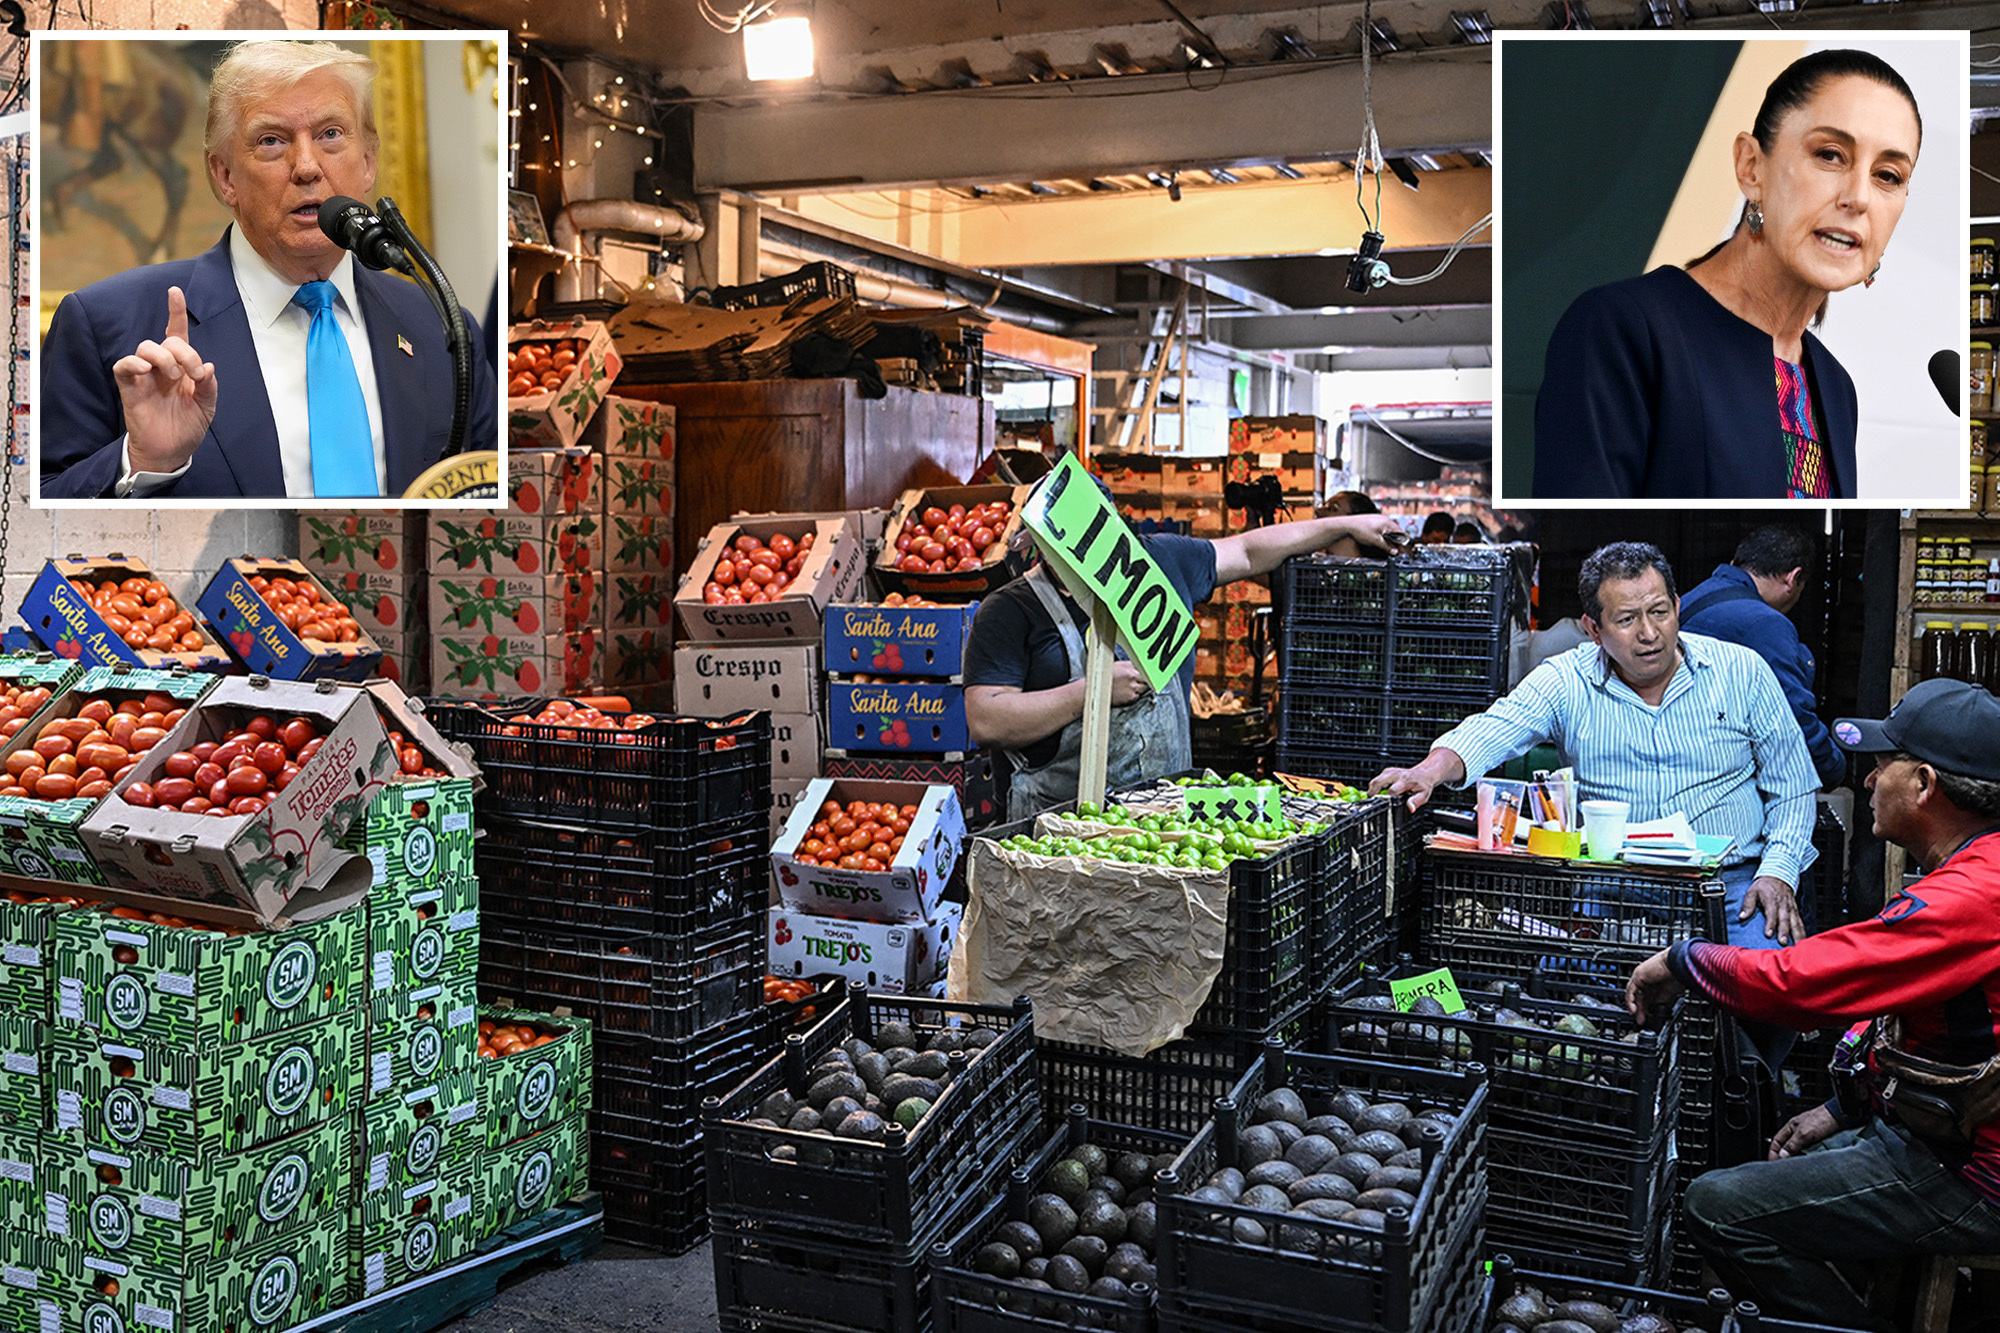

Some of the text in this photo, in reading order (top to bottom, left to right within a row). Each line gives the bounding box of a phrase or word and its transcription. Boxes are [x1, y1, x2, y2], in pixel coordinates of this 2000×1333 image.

[1042, 464, 1196, 673] LIMON
[49, 584, 121, 668] Santa Ana
[225, 581, 262, 628] Santa
[259, 624, 290, 659] Ana
[703, 608, 792, 628] Crespo
[843, 611, 940, 639] Santa Ana
[696, 653, 782, 682] Crespo
[850, 688, 947, 714] Santa Ana
[288, 737, 358, 821] Tomates
[808, 880, 883, 904] TREJO'S
[802, 935, 873, 966] TREJO'S
[279, 954, 304, 987] SM
[116, 987, 135, 1009] SM
[278, 1059, 302, 1093] SM
[528, 1073, 547, 1101] SM
[114, 1101, 133, 1122] SM
[271, 1166, 297, 1201] SM
[526, 1162, 544, 1192] SM
[99, 1207, 119, 1228] SM
[261, 1268, 285, 1304] SM
[93, 1315, 113, 1333] SM
